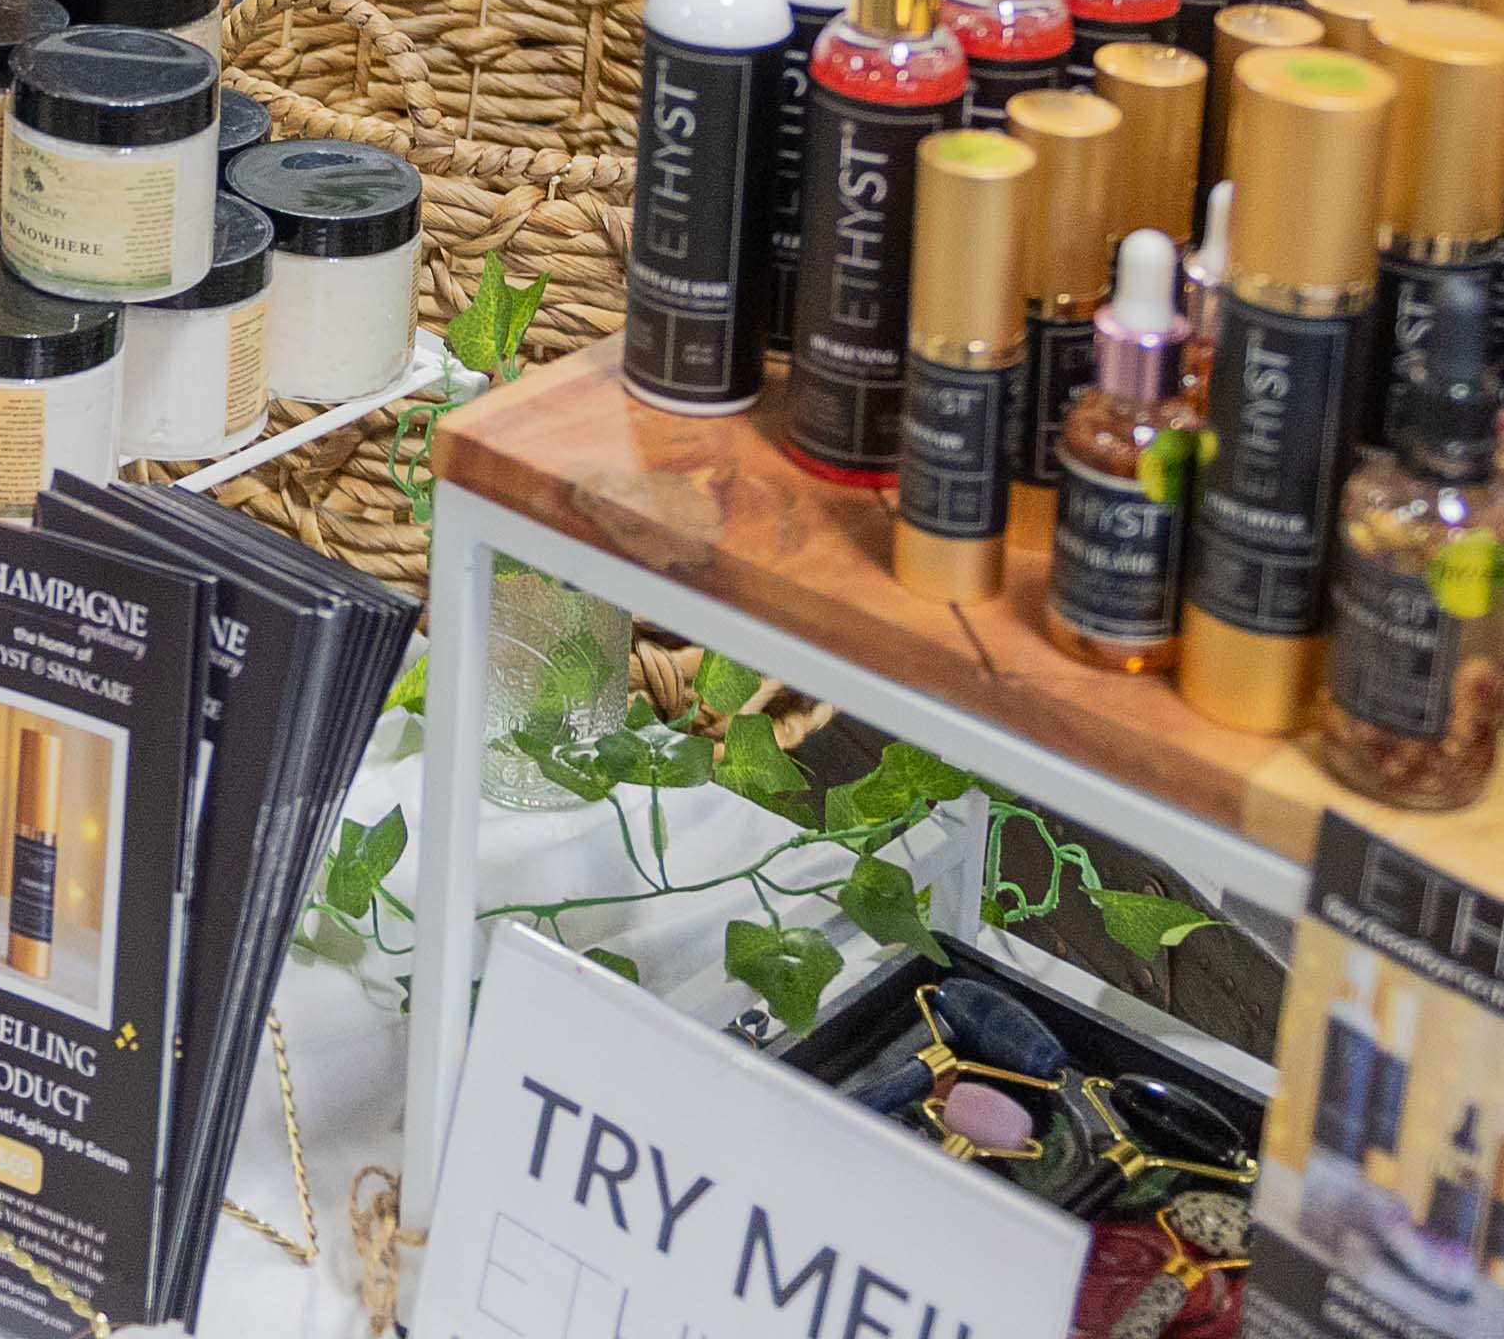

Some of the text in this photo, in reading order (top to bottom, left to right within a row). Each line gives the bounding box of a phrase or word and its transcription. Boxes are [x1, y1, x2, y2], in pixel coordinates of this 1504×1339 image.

[648, 71, 699, 263] ETHYST
[18, 221, 104, 257] NOWHERE
[831, 135, 891, 328] ETHYST
[46, 662, 134, 706] SKINCARE
[60, 1130, 84, 1155] Eye
[85, 1141, 130, 1174] Serum
[520, 1074, 717, 1256] TRY
